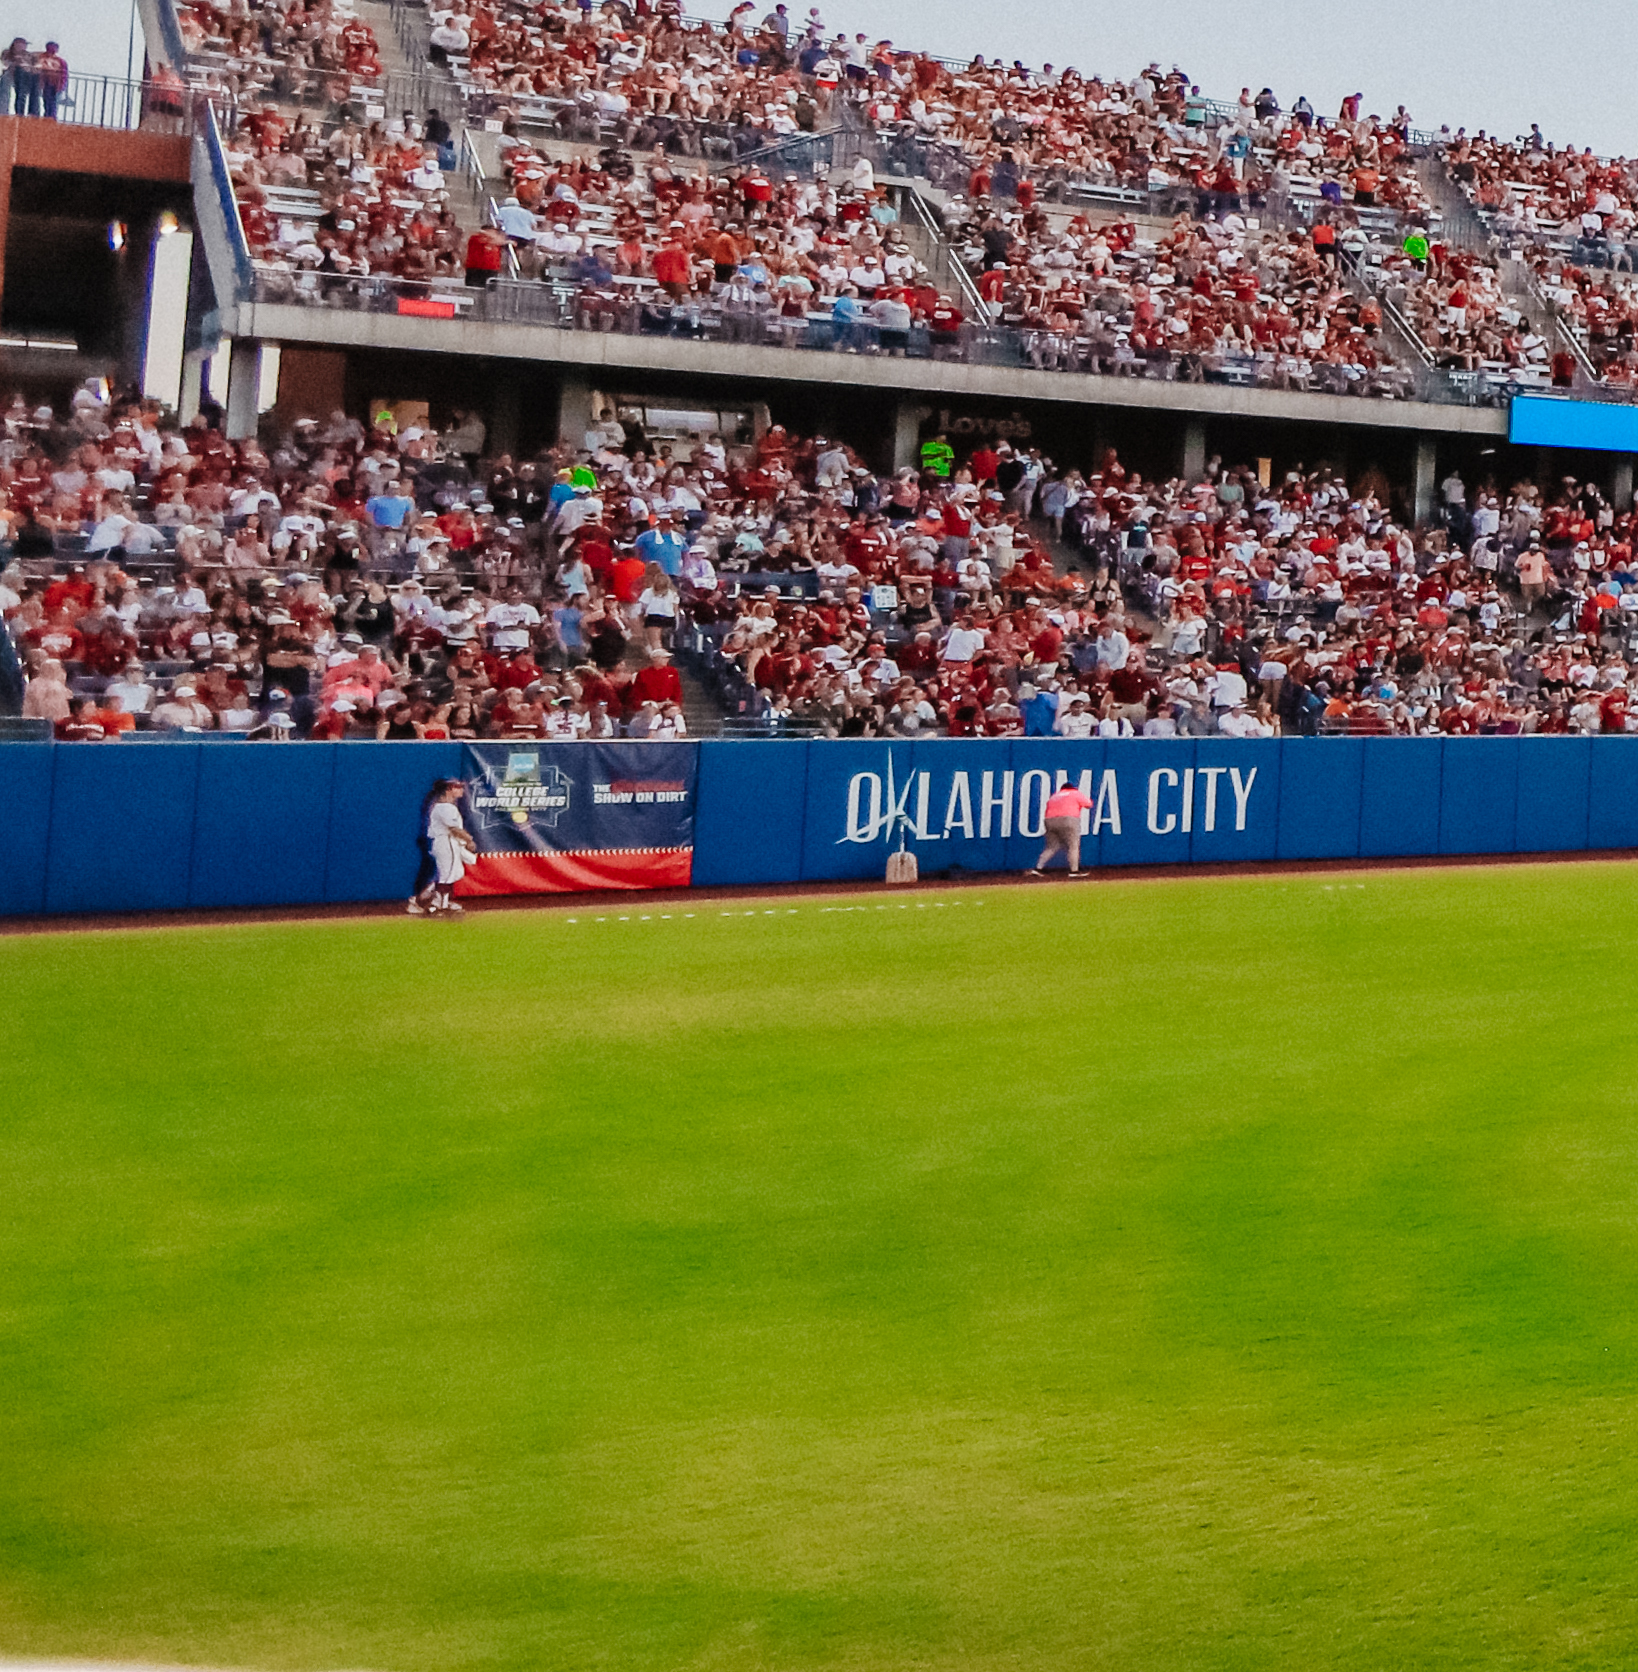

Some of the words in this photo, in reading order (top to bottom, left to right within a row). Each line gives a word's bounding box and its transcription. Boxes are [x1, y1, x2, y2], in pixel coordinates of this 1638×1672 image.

[495, 786, 549, 797] COLLEGE
[593, 792, 633, 803] SHOW
[635, 792, 654, 803] ON
[656, 791, 688, 803] DIRT
[476, 796, 520, 807] WORLD
[521, 796, 566, 807] SERIES
[1147, 766, 1258, 835] CITY
